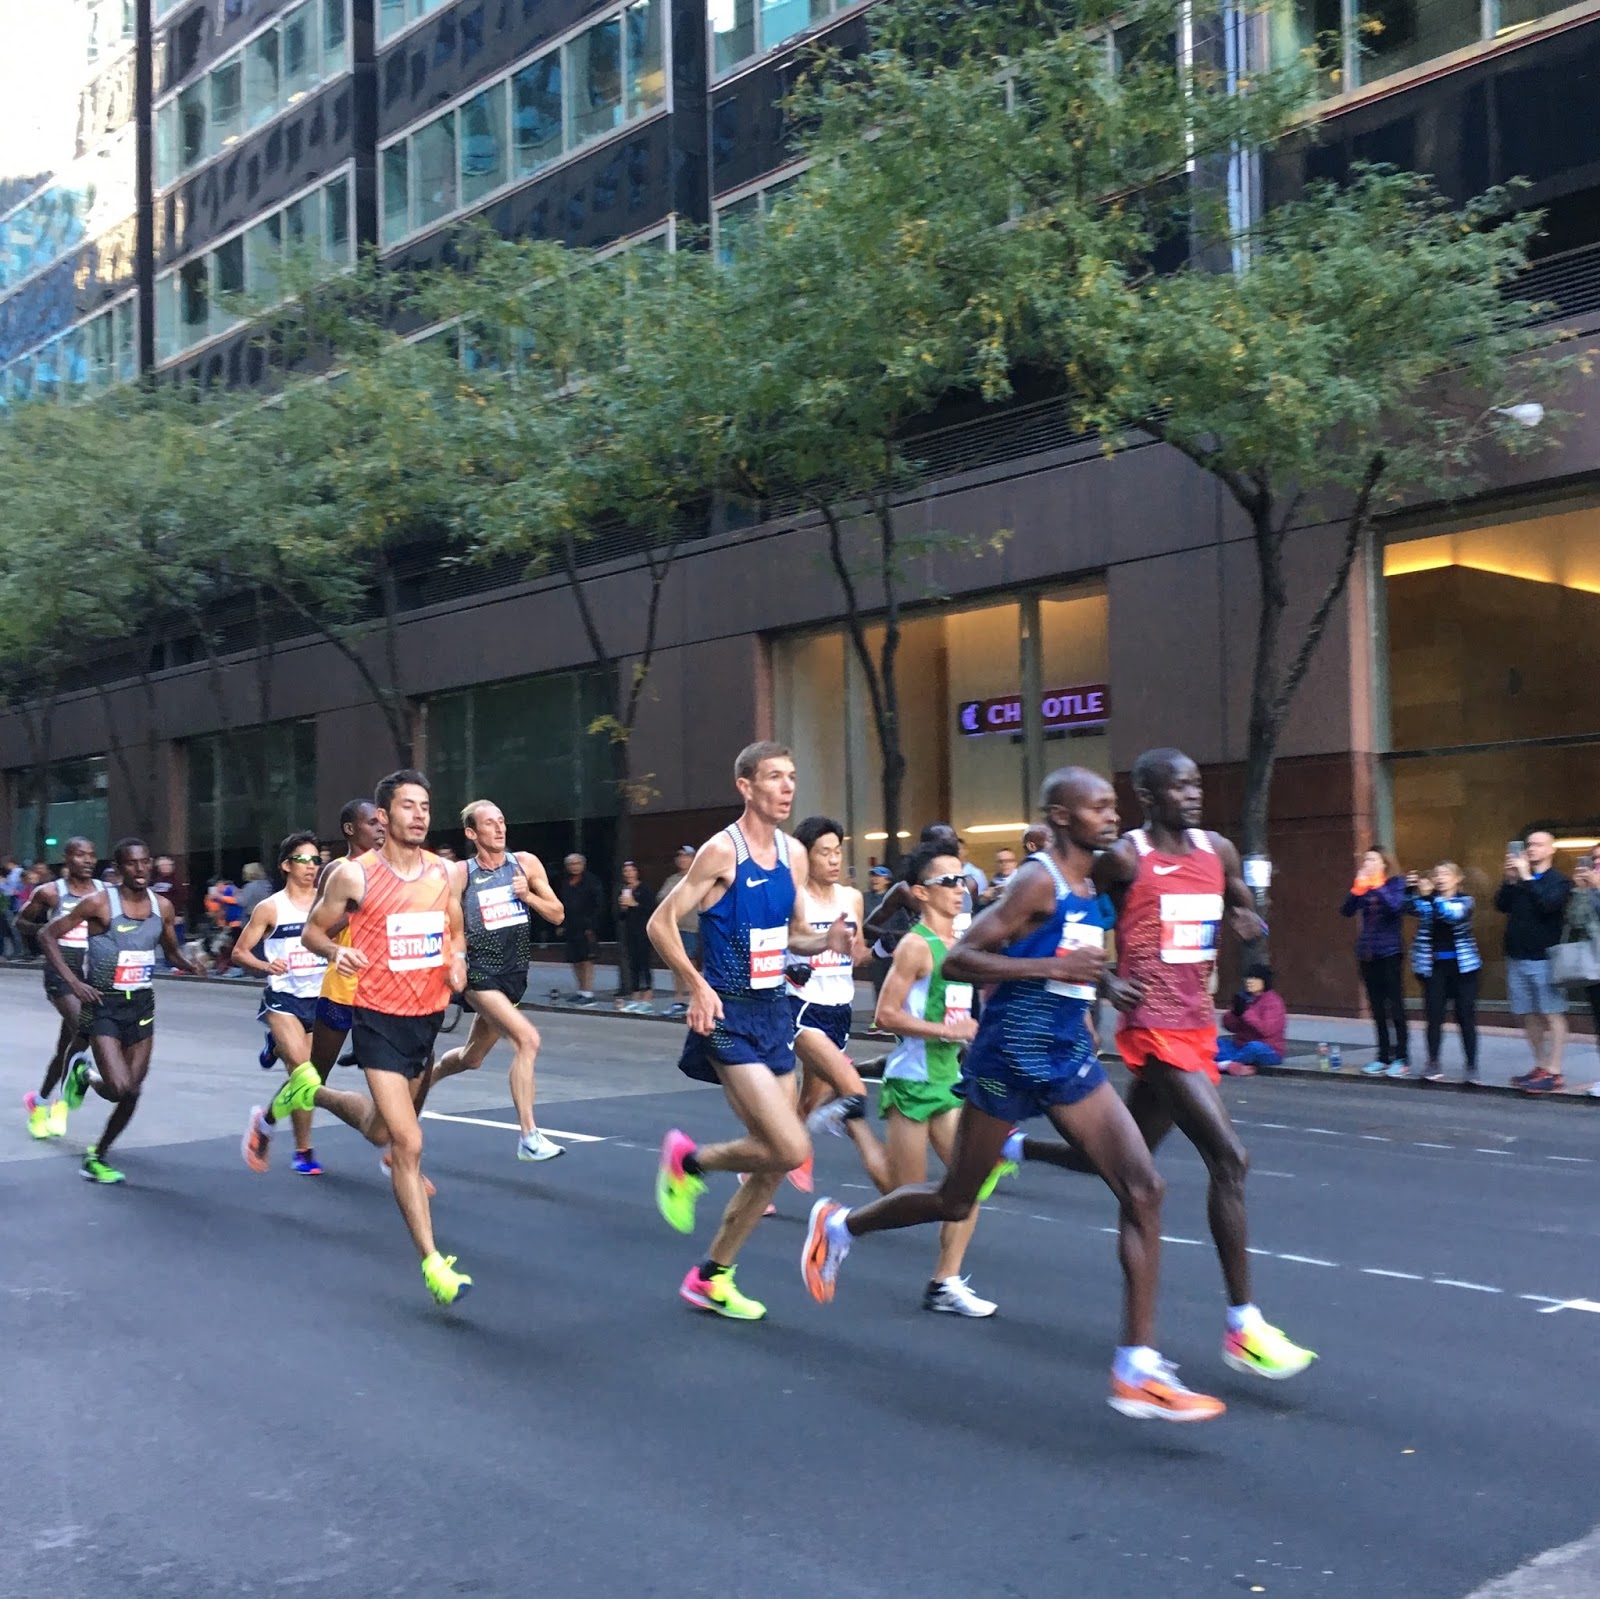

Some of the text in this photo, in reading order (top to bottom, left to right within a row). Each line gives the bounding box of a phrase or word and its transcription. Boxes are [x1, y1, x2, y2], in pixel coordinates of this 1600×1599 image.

[987, 692, 1104, 724] CHOTLE
[483, 901, 525, 920] OVERALL
[390, 937, 443, 957] ESTRADA
